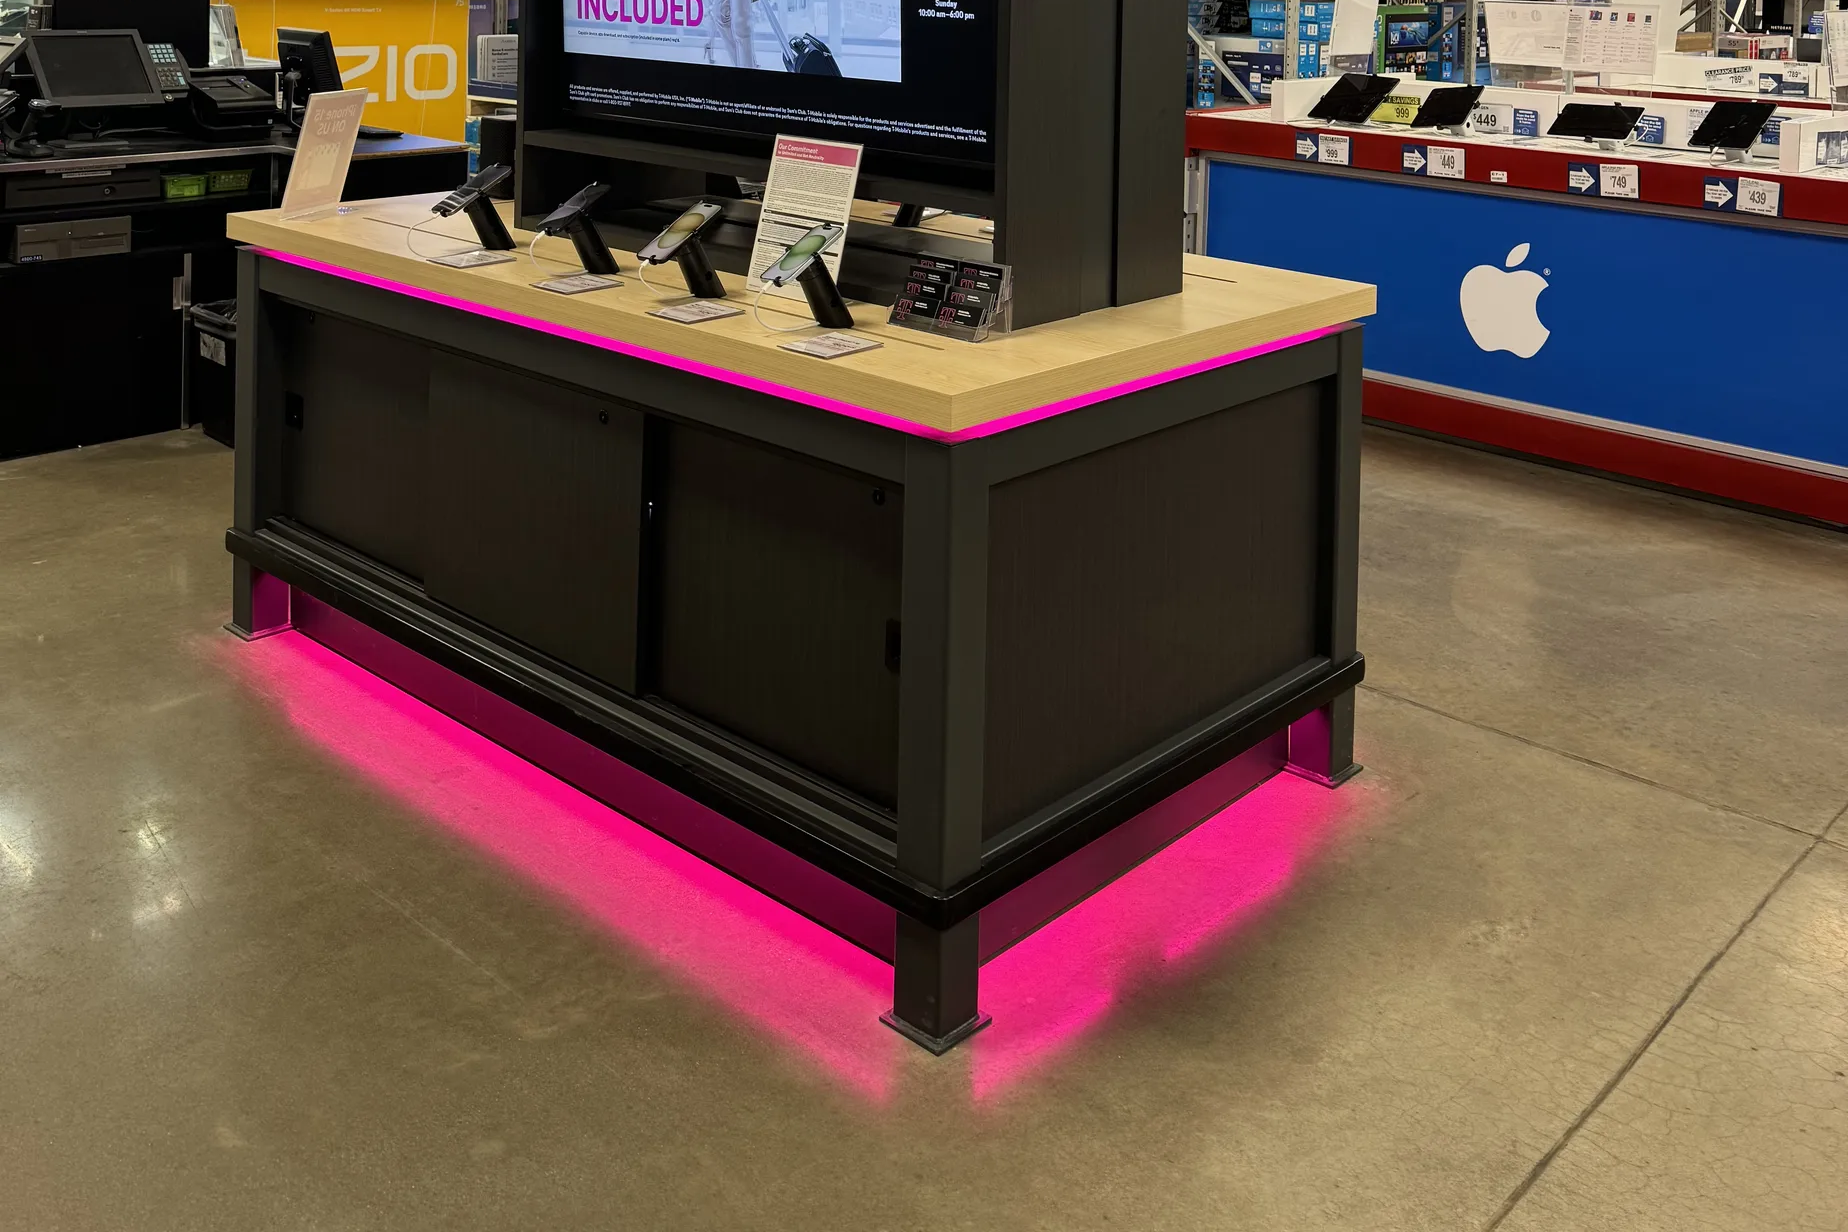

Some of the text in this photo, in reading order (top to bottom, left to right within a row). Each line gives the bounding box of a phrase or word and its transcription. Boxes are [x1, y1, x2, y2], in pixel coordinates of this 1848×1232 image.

[935, 0, 958, 9] Sunday
[918, 8, 936, 17] 10:00
[964, 12, 975, 21] pm
[334, 44, 458, 104] ZIO
[1704, 68, 1735, 77] CLEARANCE
[1391, 96, 1419, 105] SAVINGS
[1473, 113, 1497, 127] $449
[778, 142, 819, 154] Our Commitment
[1440, 154, 1455, 170] $449
[1609, 175, 1627, 189] $749
[1748, 189, 1767, 205] $439
